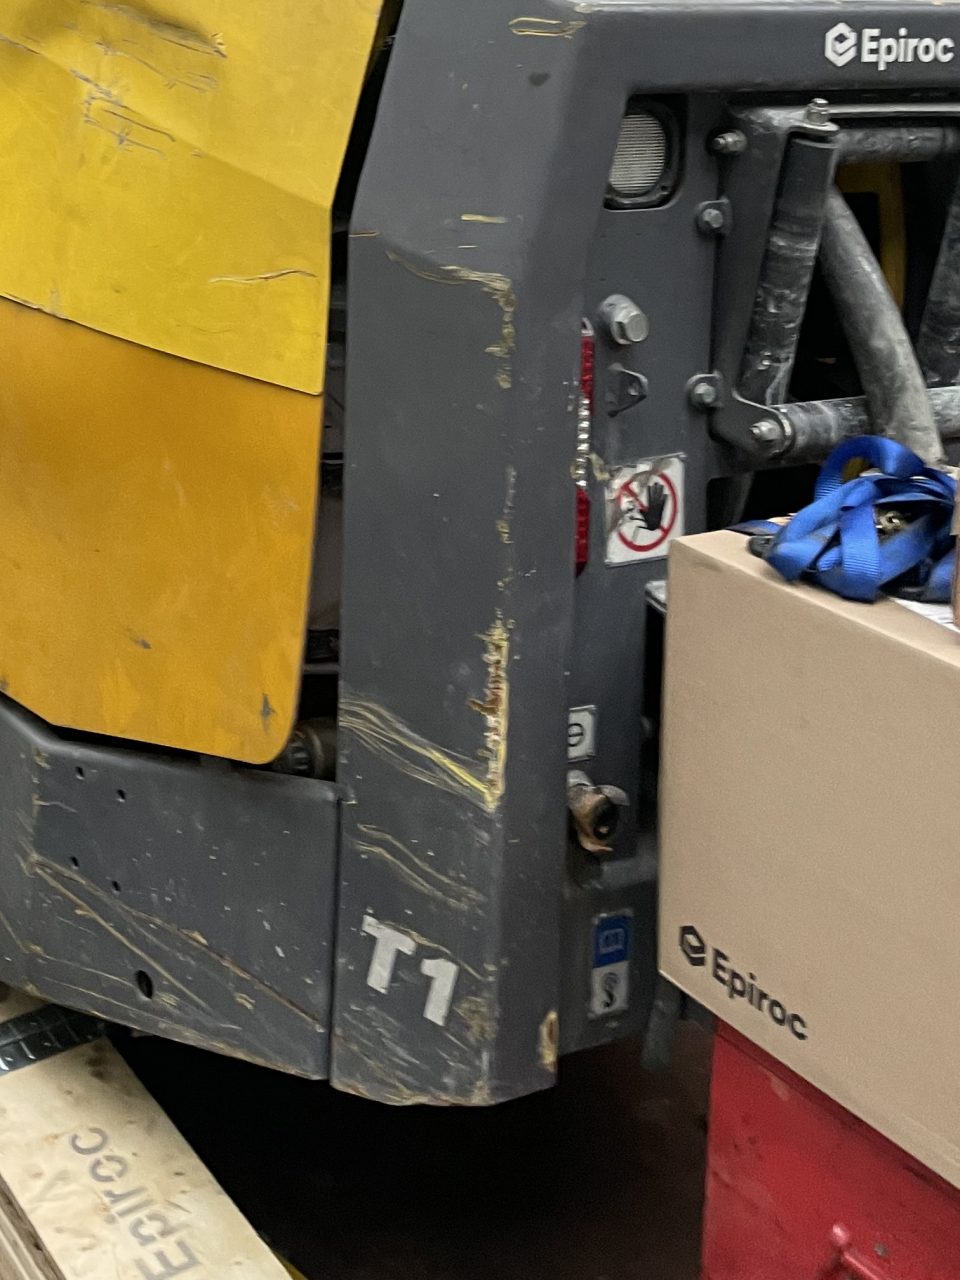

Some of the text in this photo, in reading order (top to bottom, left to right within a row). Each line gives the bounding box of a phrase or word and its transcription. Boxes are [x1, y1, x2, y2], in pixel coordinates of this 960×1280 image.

[861, 27, 955, 71] Epiroc
[362, 914, 460, 1027] T1
[712, 946, 808, 1041] Epiroc
[70, 1126, 202, 1280] Epiroc
